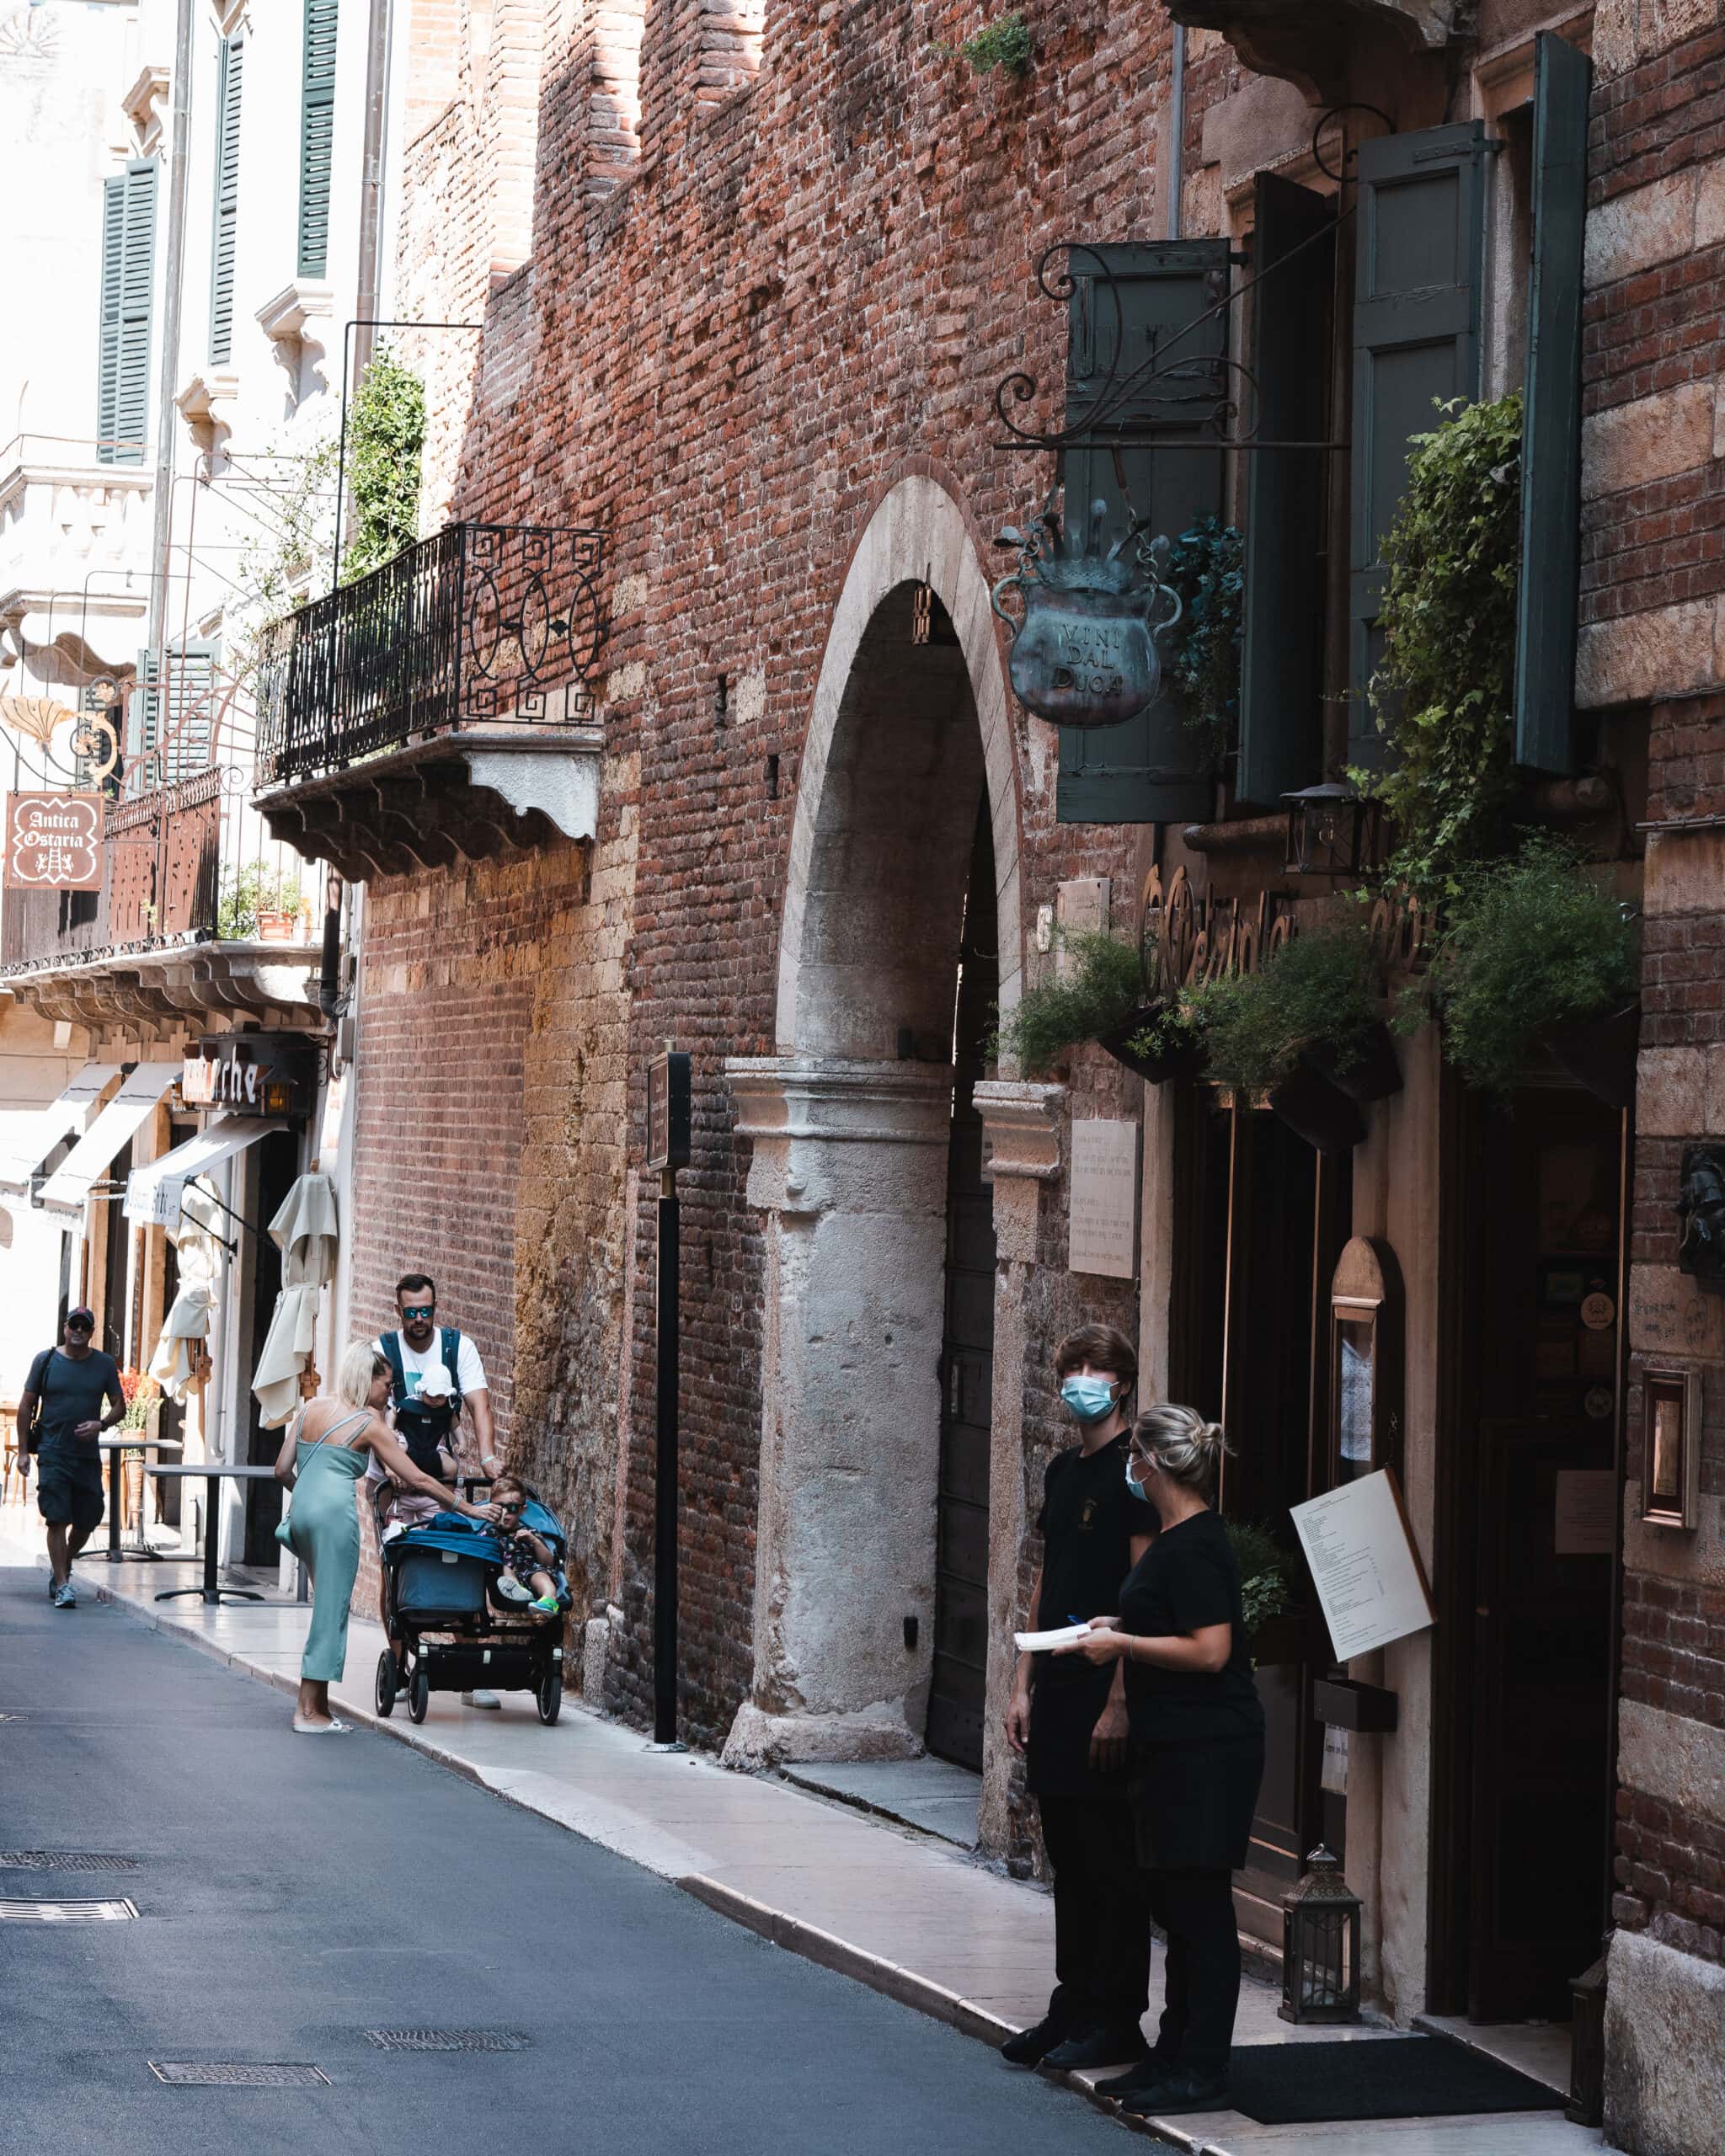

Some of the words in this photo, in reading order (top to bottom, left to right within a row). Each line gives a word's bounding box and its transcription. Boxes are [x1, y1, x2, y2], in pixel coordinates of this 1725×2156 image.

[1063, 624, 1119, 648] VINI
[1067, 646, 1114, 669] DAL
[29, 811, 79, 829] Antica
[24, 830, 83, 848] Ostaria
